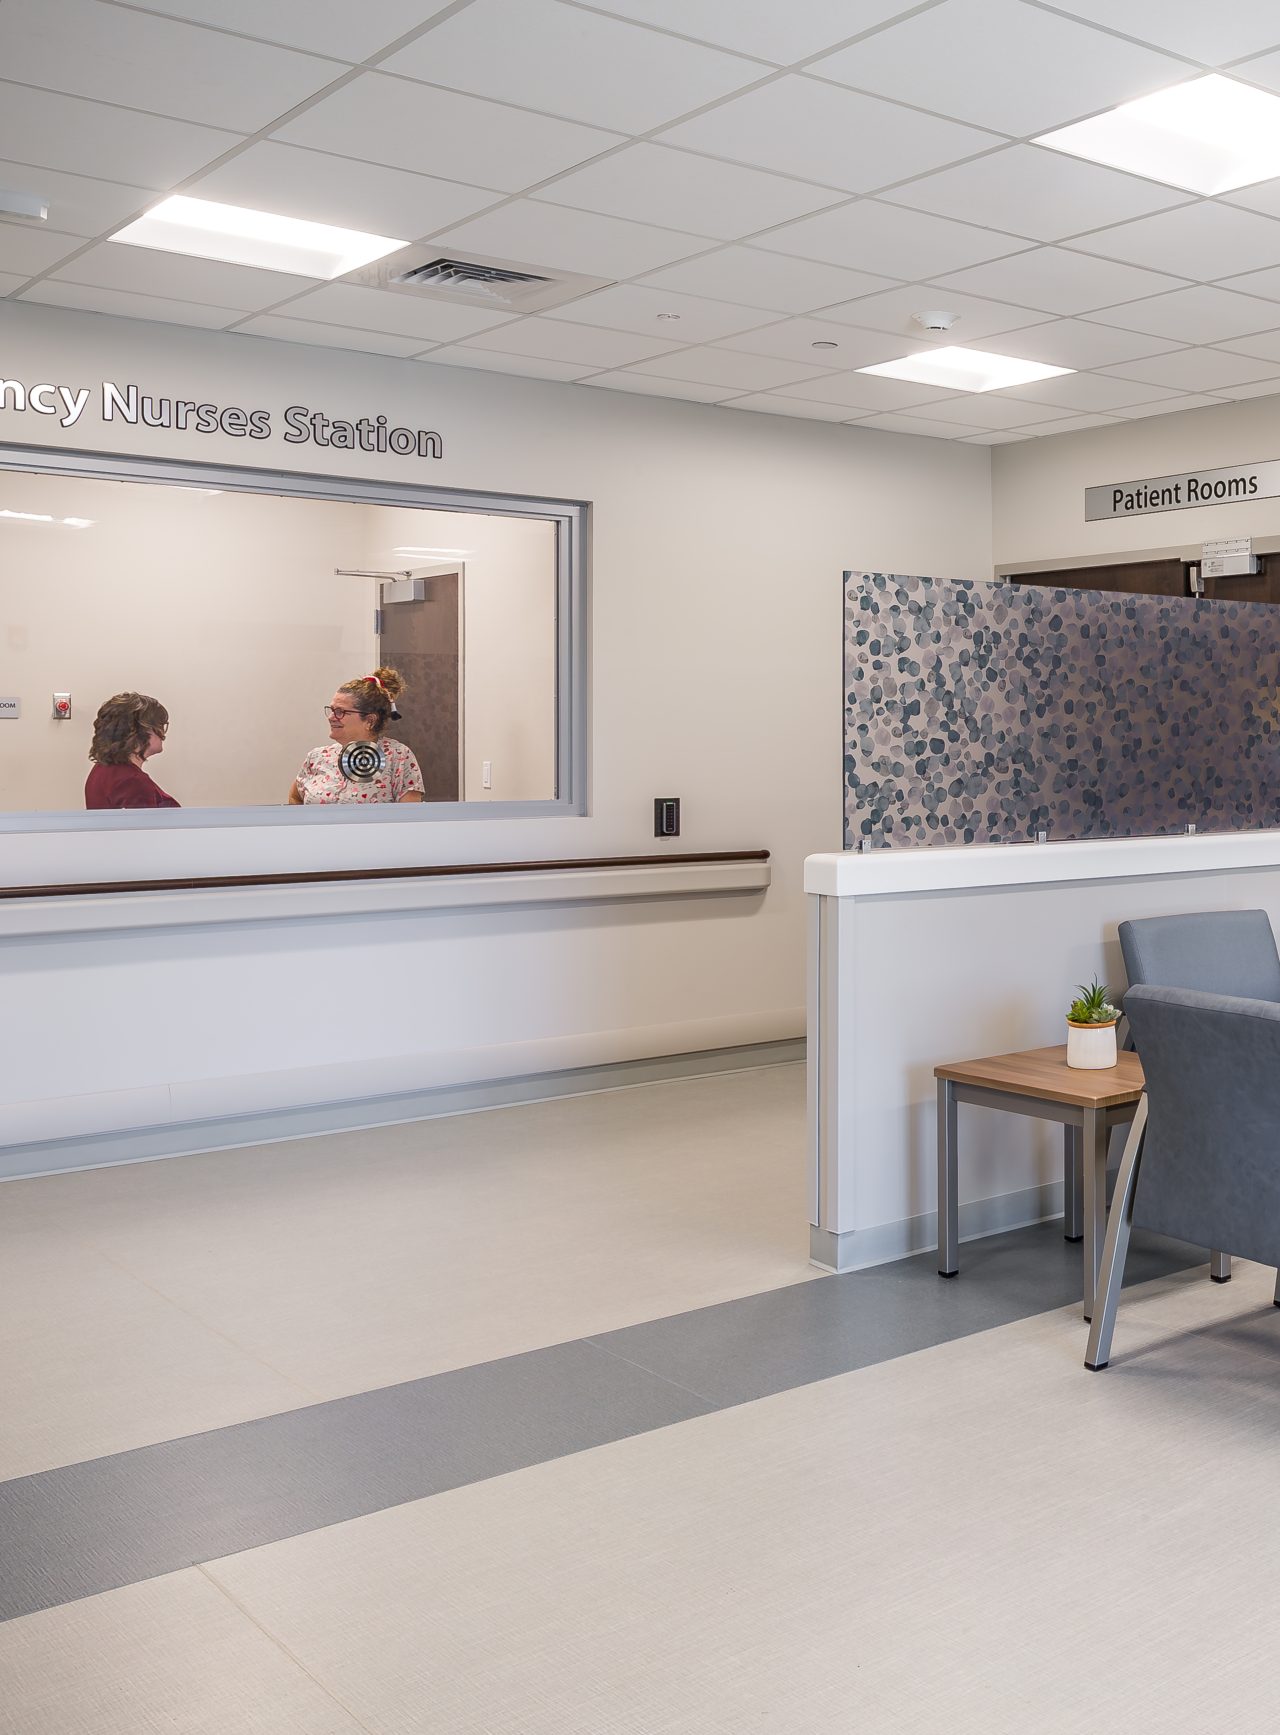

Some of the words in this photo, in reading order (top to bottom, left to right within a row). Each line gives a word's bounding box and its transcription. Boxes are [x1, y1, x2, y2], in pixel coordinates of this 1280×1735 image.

[0, 379, 91, 427] ncy
[102, 382, 271, 440] Nurses
[284, 406, 443, 459] Station
[1112, 483, 1182, 512] Patient
[1187, 475, 1258, 502] Rooms
